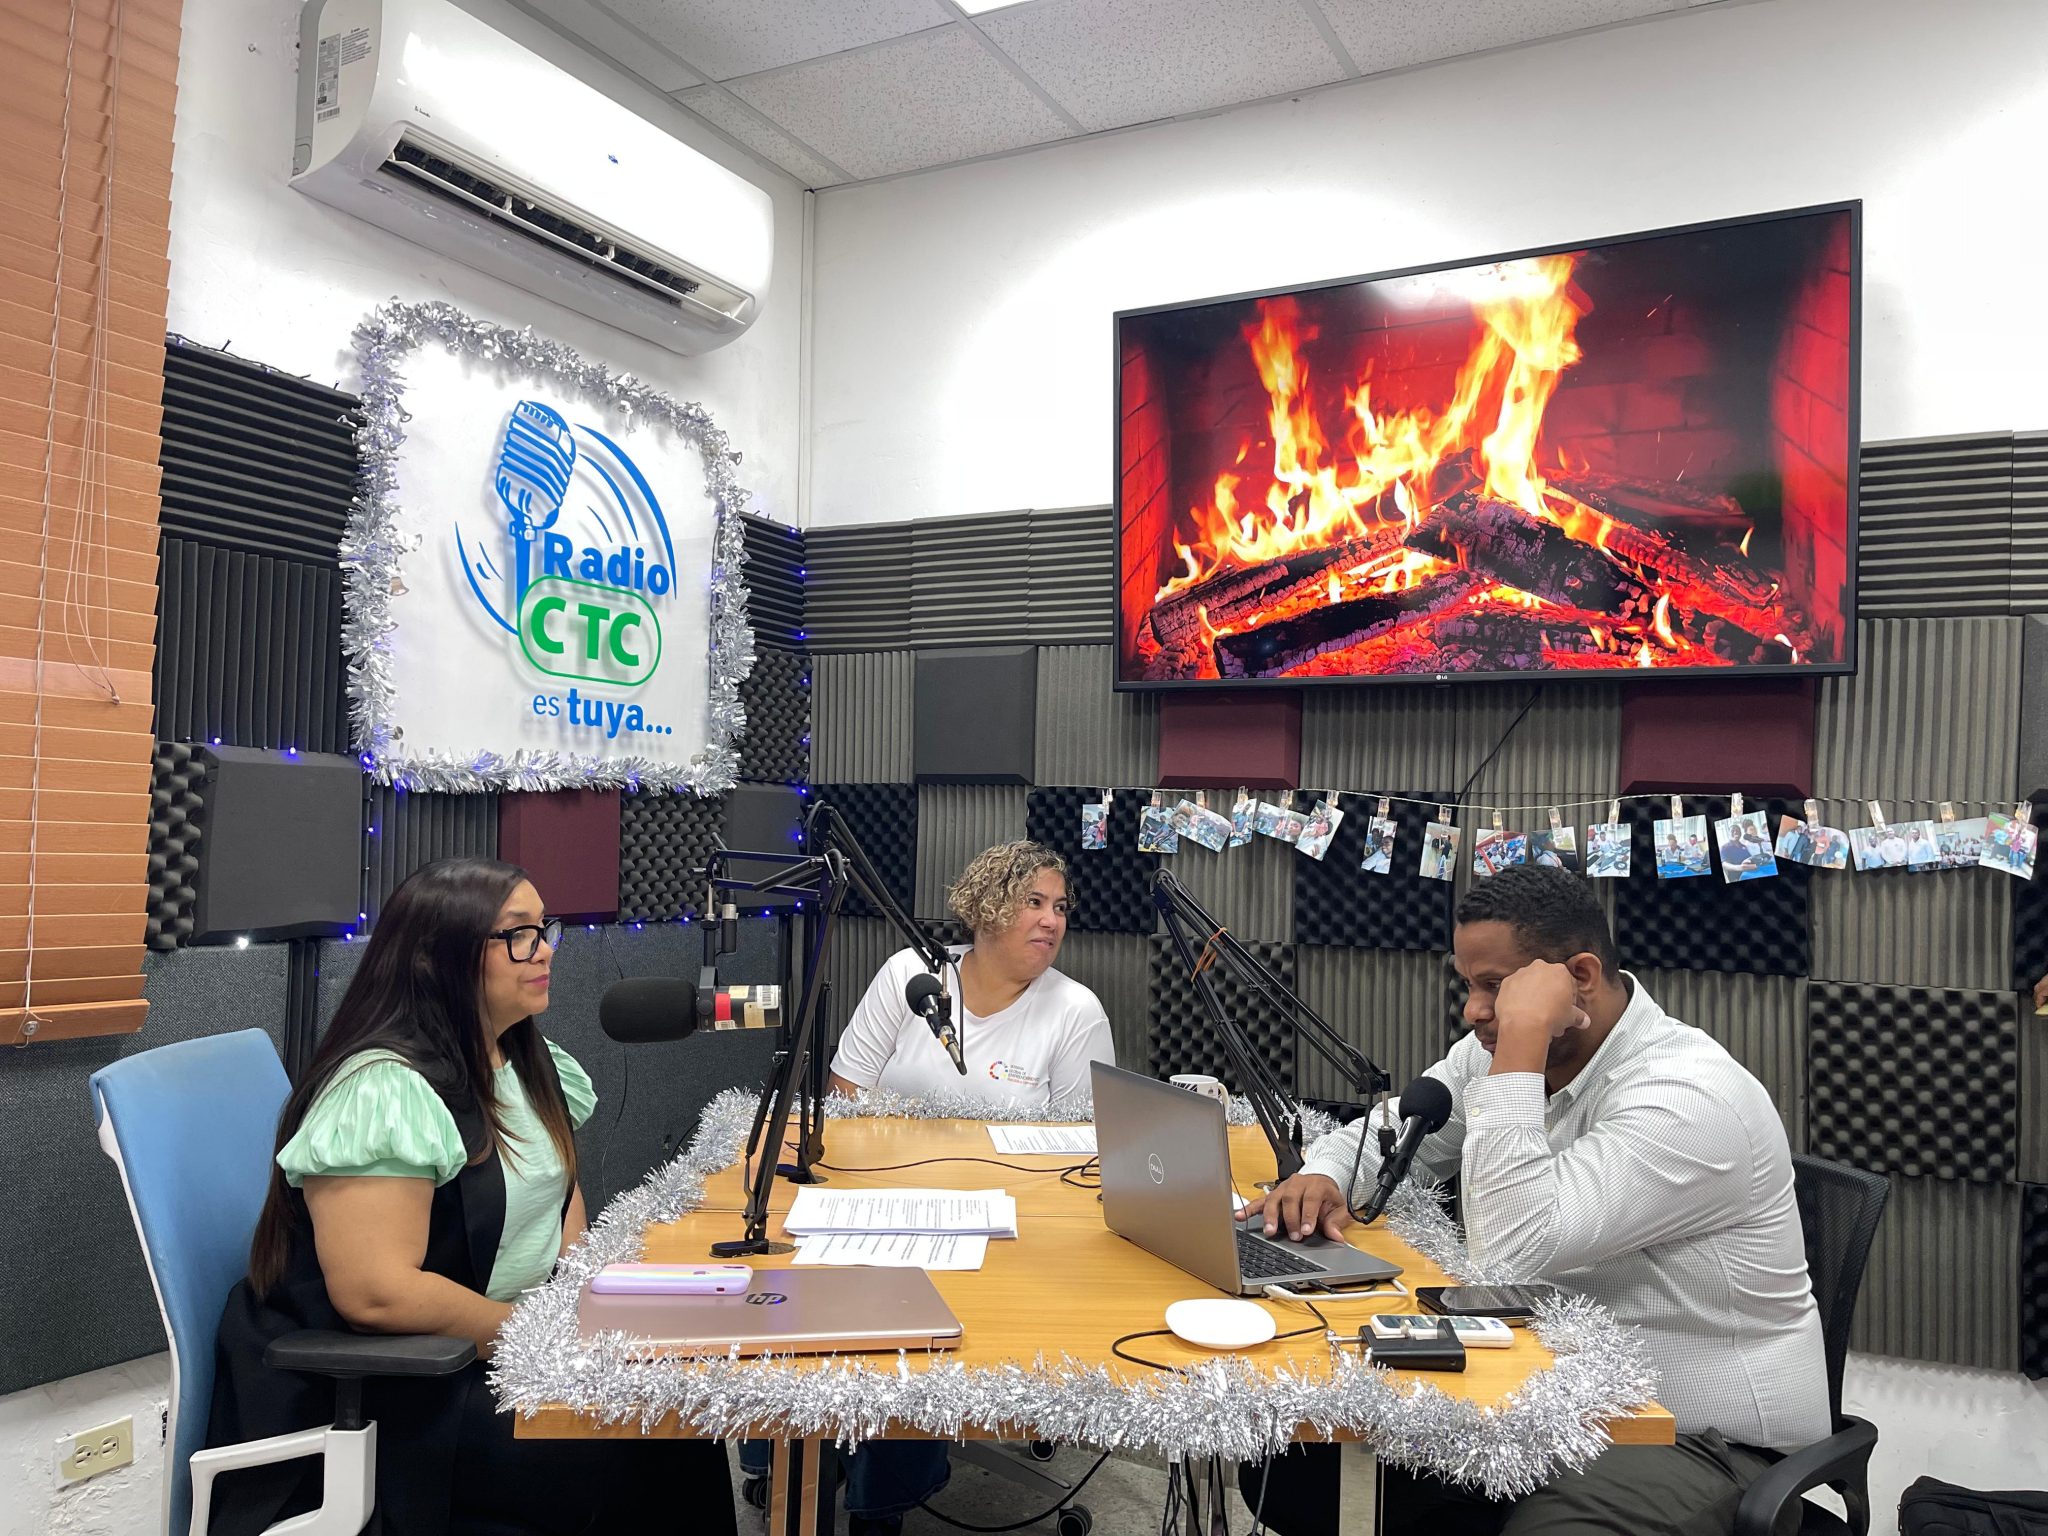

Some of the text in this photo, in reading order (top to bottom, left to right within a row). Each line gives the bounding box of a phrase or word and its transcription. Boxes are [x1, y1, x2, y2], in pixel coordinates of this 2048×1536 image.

[542, 531, 670, 596] Radio
[529, 596, 641, 667] CTC
[532, 687, 673, 740] es tuya...
[745, 1293, 788, 1305] hp
